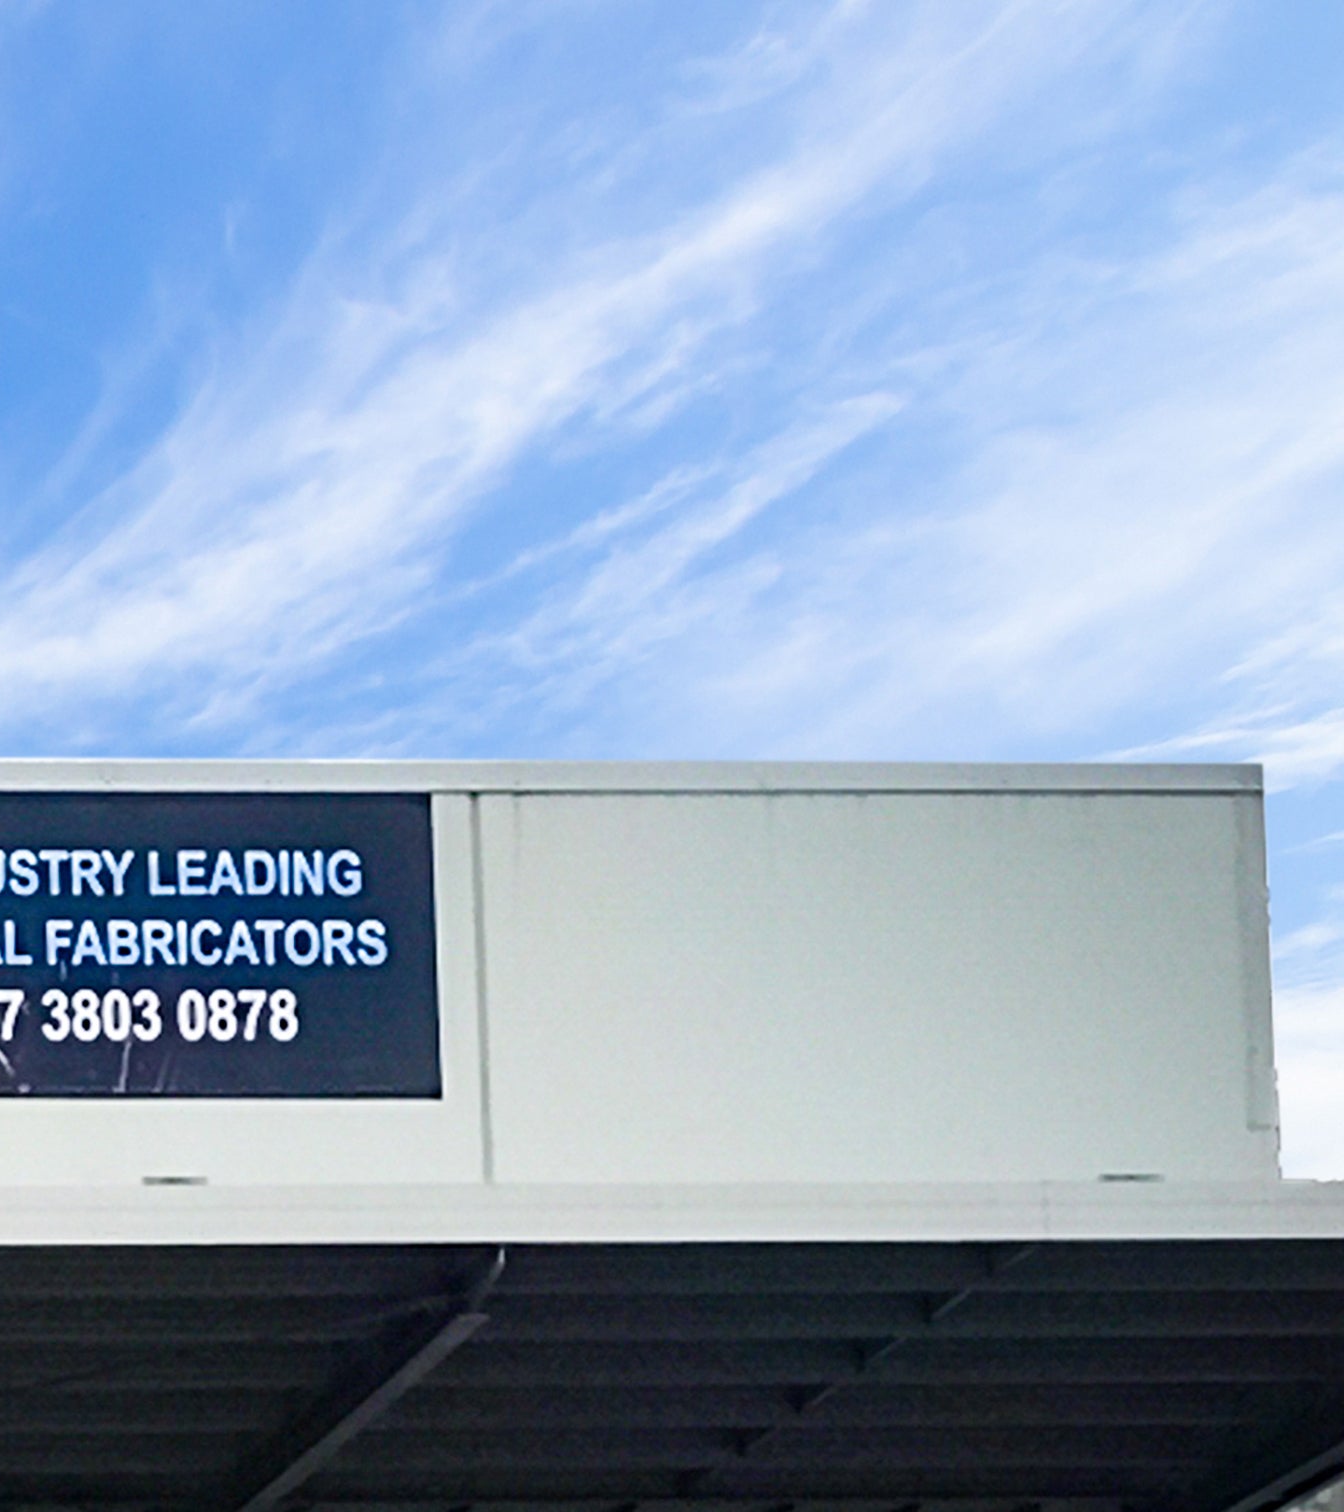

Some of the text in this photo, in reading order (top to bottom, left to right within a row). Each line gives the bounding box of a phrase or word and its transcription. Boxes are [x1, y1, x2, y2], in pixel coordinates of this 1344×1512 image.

[147, 849, 362, 896] LEADING
[45, 919, 388, 966] FABRICATORS
[41, 988, 162, 1042] 3803
[177, 988, 299, 1042] 0878
